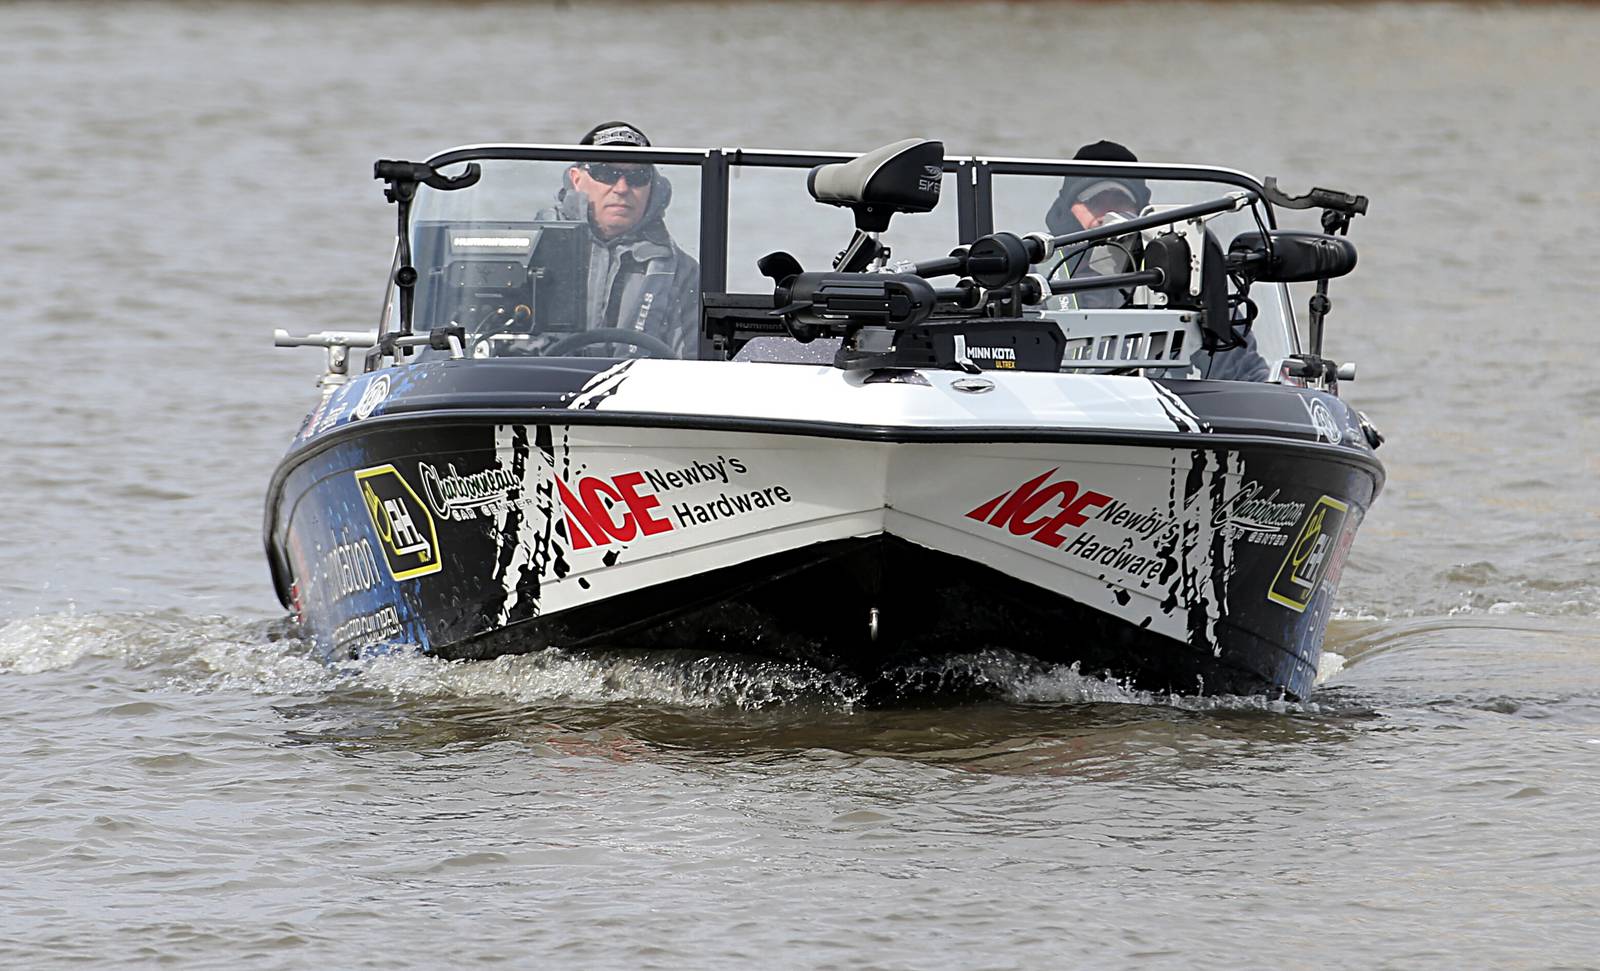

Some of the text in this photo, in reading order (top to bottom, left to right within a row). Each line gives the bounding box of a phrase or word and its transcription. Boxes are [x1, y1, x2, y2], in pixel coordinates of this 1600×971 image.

[966, 346, 1017, 360] MINN KOTA
[644, 455, 748, 493] Newby's
[451, 498, 533, 521] CAR CENTER
[554, 471, 675, 551] ACE
[672, 484, 793, 528] Hardware
[963, 465, 1114, 548] ACE
[1094, 498, 1180, 542] Newby's
[1064, 531, 1164, 580] Hardware
